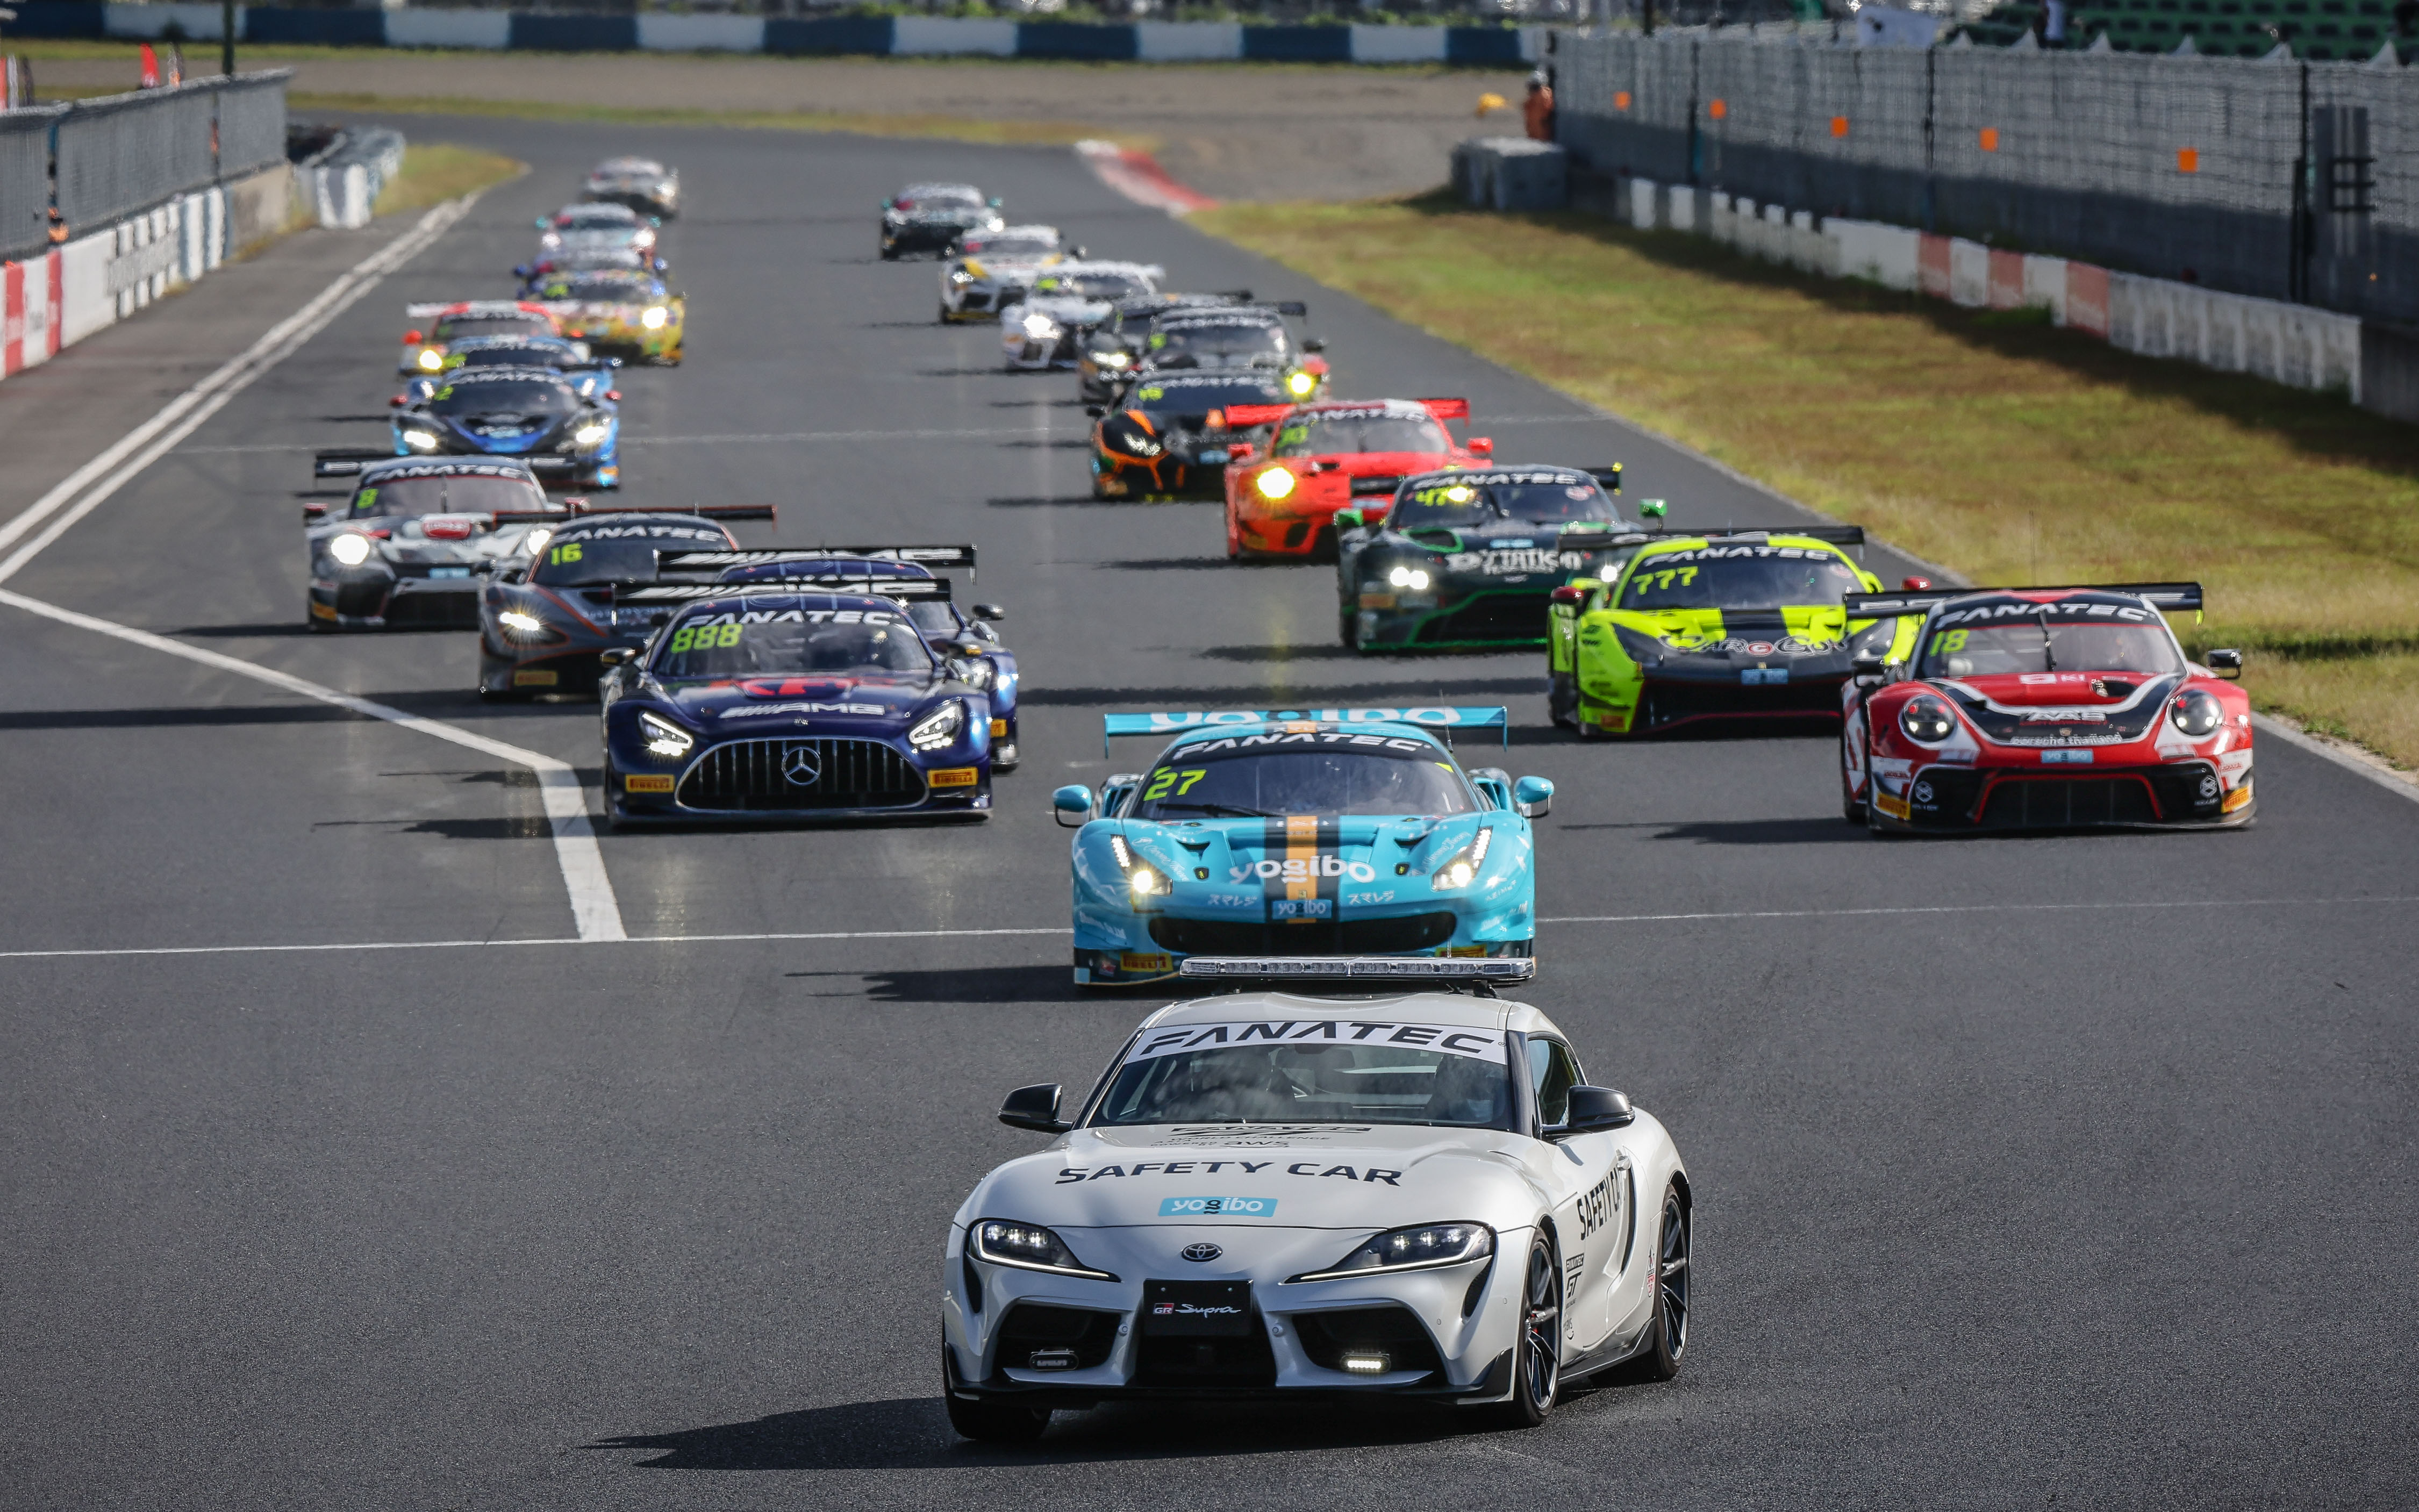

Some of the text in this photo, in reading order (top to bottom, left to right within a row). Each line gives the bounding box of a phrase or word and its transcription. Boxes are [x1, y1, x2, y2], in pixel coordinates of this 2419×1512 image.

[551, 543, 583, 565] 16
[1643, 546, 1828, 567] FANATEC
[1631, 566, 1699, 595] 777
[681, 610, 894, 629] FANATEC
[1934, 603, 2150, 629] FANATEC
[671, 623, 743, 654] 888
[1928, 629, 1970, 657] 18
[1172, 733, 1423, 761] FANATEC
[1143, 769, 1207, 801] 27
[1229, 855, 1376, 884] yogibo
[1278, 900, 1327, 917] yogibo
[1140, 1022, 1494, 1055] FANATEC
[1054, 1161, 1402, 1187] SAFETY CAR
[1171, 1198, 1264, 1215] yogibo
[1576, 1176, 1612, 1241] SAFETY
[1175, 1303, 1242, 1318] Supra
